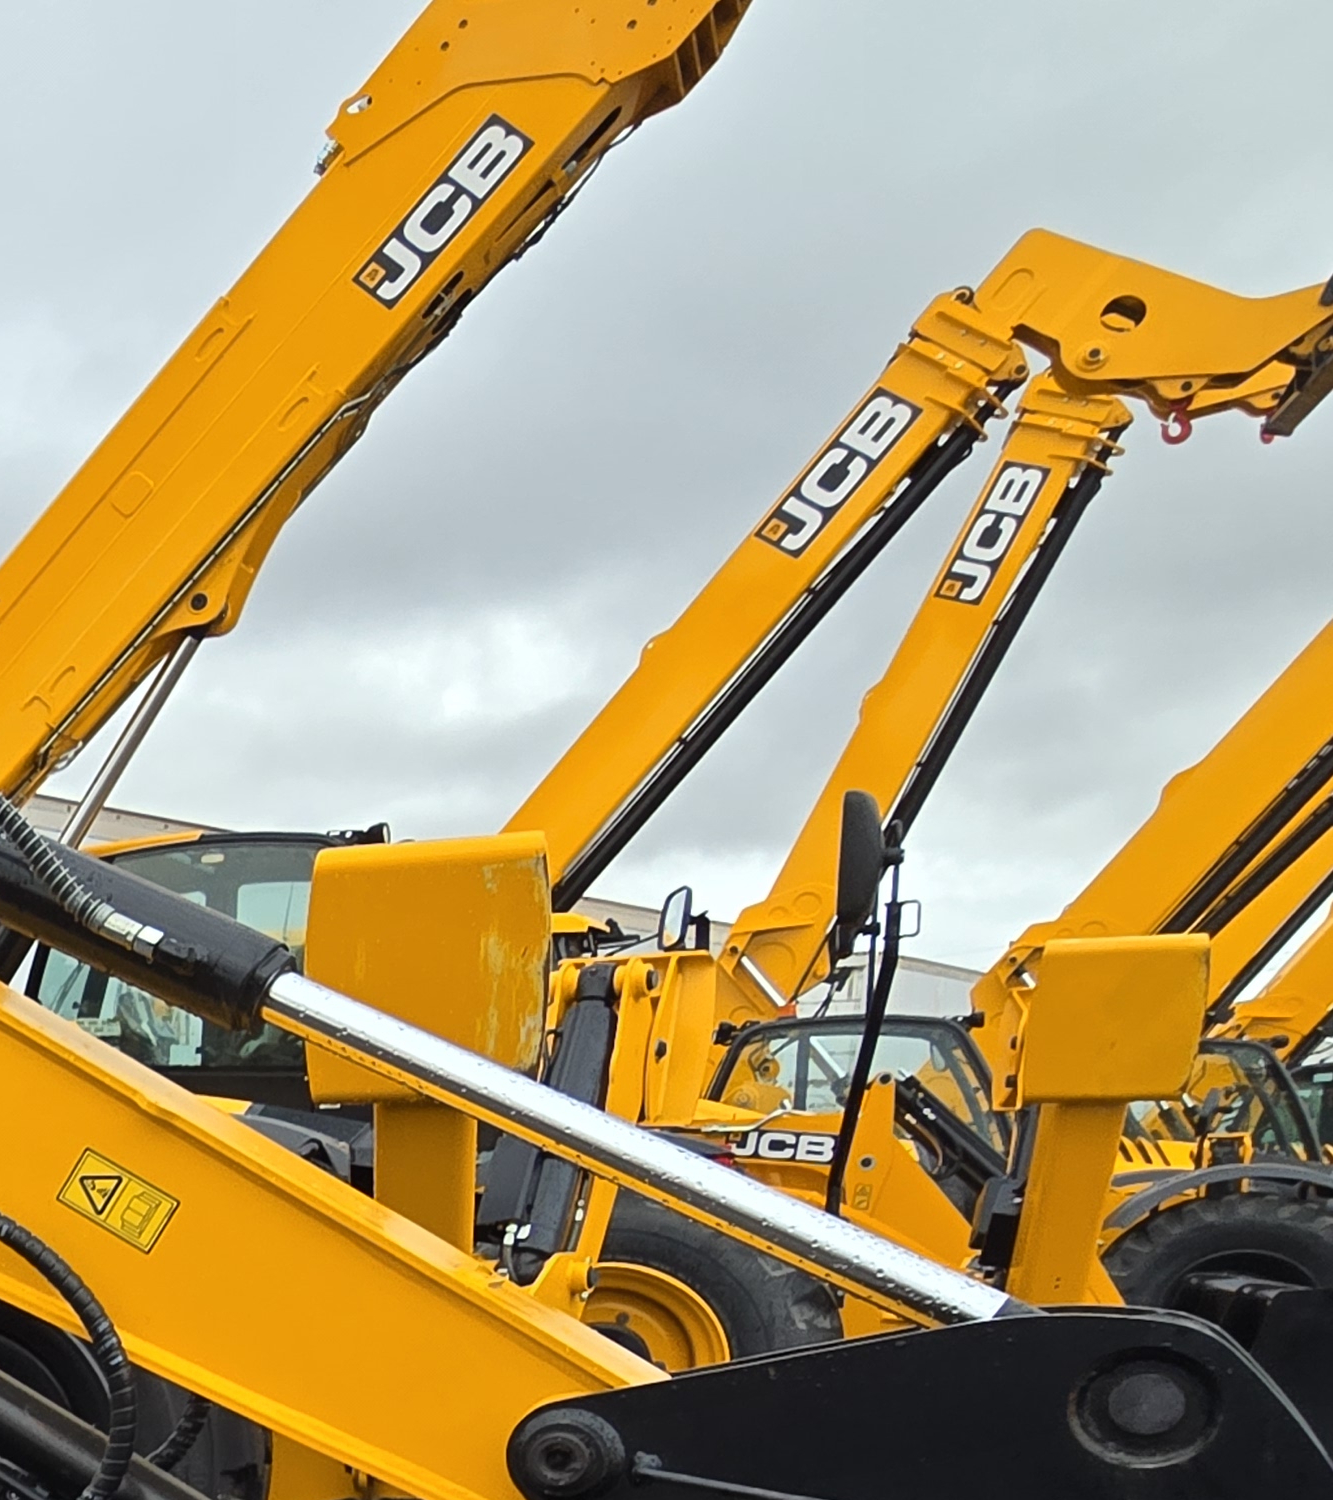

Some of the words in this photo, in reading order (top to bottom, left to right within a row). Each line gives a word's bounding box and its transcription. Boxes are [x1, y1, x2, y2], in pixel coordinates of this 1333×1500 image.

[375, 123, 525, 301] JCB
[777, 395, 912, 553] JCB
[958, 465, 1043, 602] JCB
[731, 1131, 835, 1162] JCB
